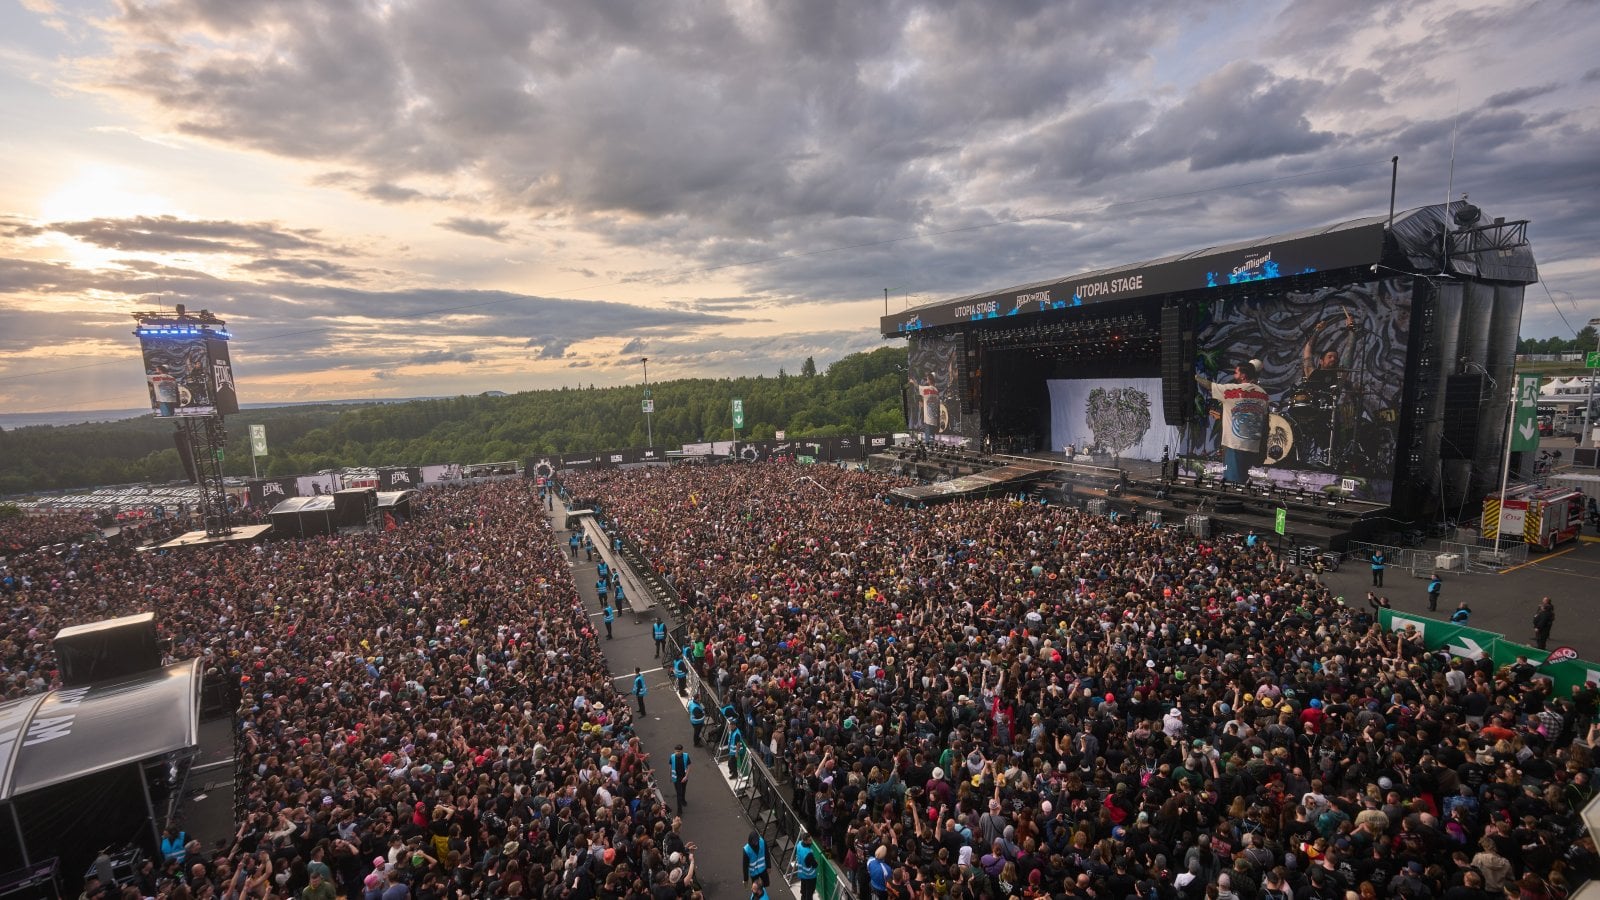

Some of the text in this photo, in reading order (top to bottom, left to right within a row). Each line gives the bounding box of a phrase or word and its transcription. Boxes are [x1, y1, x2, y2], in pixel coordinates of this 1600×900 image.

[1076, 275, 1143, 299] UTOPIA STAGE
[954, 300, 997, 318] UTOPIA STAGE
[1016, 293, 1031, 310] ROCK
[1035, 290, 1051, 305] RING
[391, 472, 410, 485] RING
